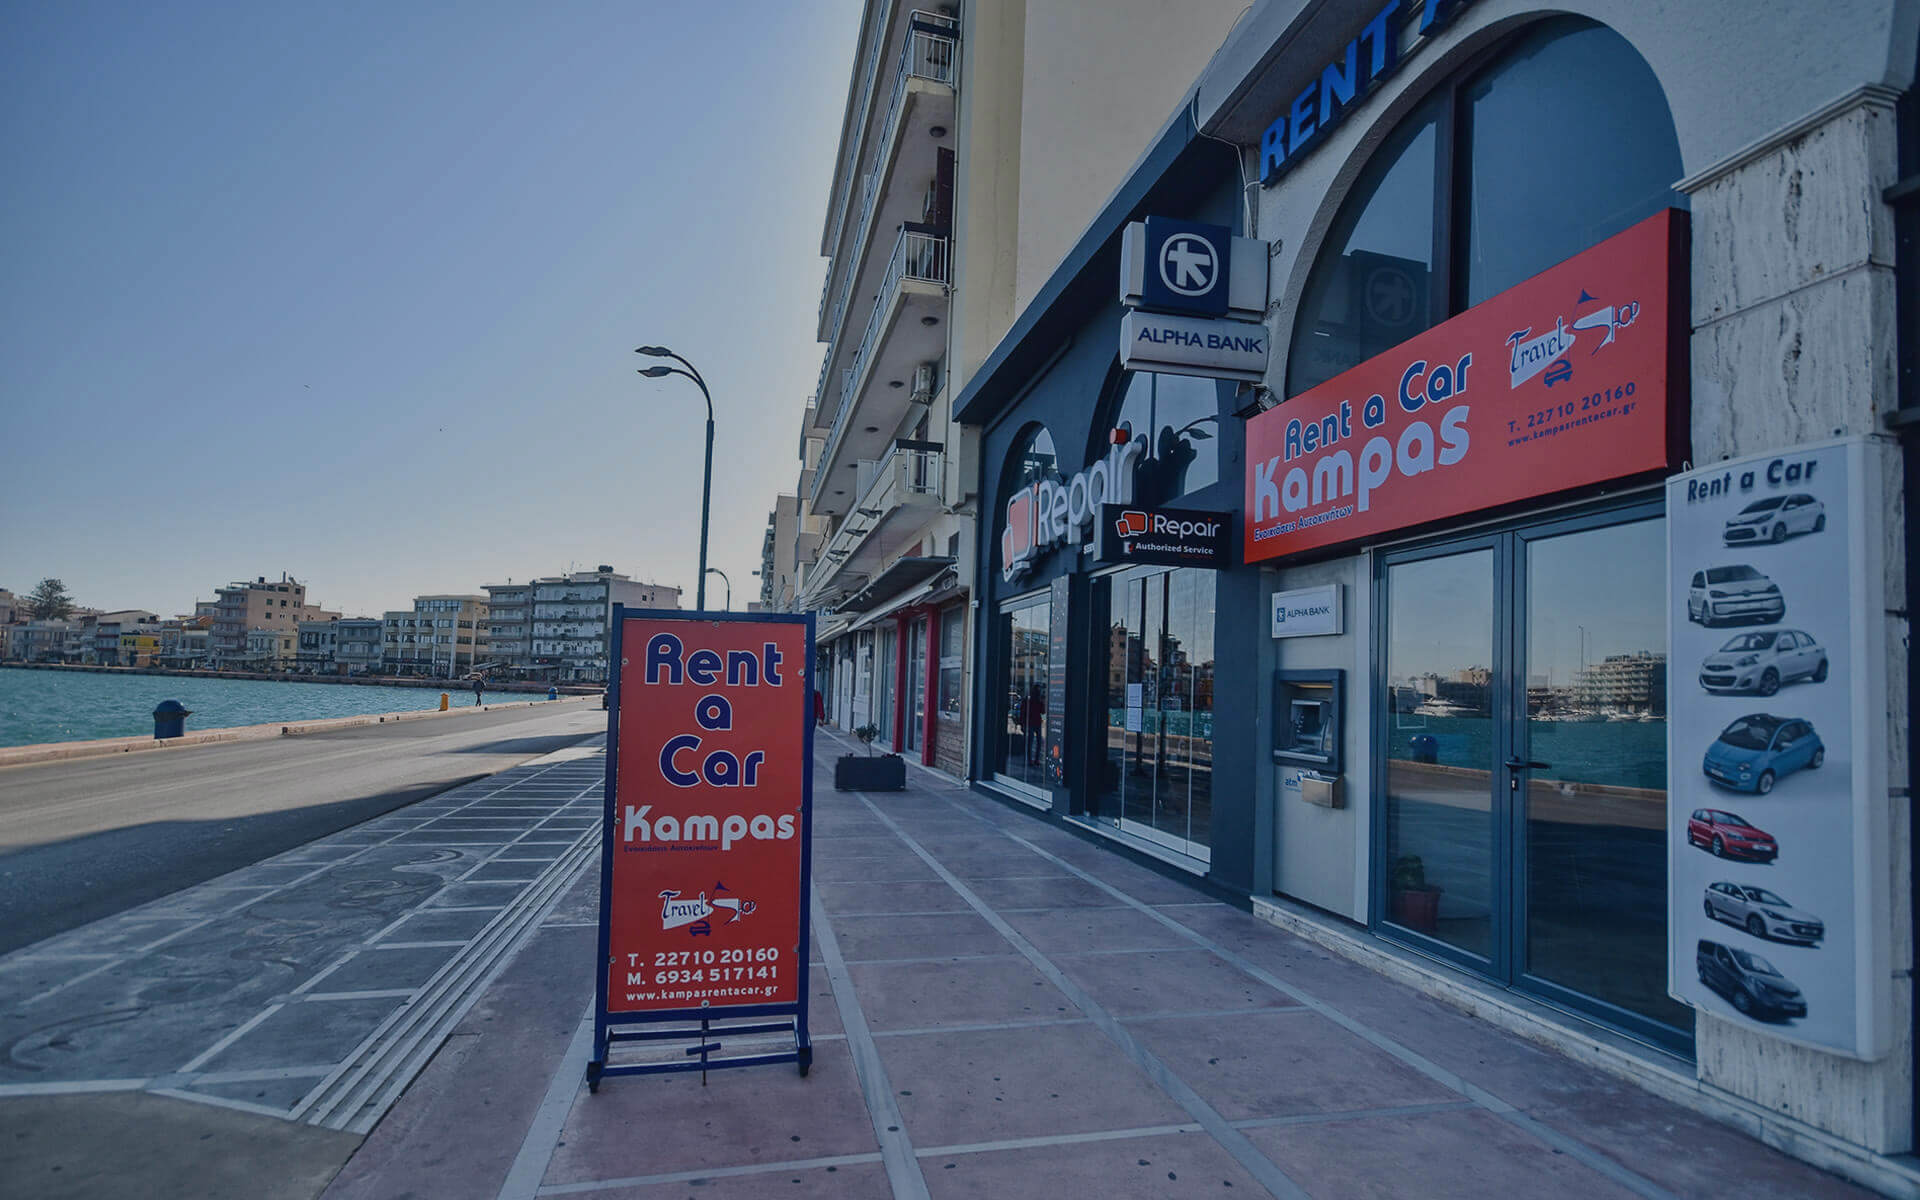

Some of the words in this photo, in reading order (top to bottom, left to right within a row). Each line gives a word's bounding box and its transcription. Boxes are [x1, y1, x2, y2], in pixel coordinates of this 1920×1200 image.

[1260, 0, 1400, 184] RENT
[1138, 327, 1203, 348] ALPHA
[1207, 334, 1264, 353] BANK
[1505, 316, 1565, 373] Travel
[1284, 400, 1352, 463] Rent
[1363, 394, 1385, 428] a
[1399, 352, 1472, 412] Car
[1508, 421, 1521, 433] T.
[1527, 402, 1575, 428] 22710
[1581, 382, 1636, 410] 20160
[1508, 401, 1636, 447] www.kampasrentacar.gr
[1254, 405, 1471, 523] Kampas
[1687, 472, 1732, 502] Rent
[1740, 470, 1754, 489] a
[1767, 459, 1817, 485] Car
[1032, 427, 1143, 546] iRepair
[1149, 513, 1221, 539] iRepair
[1135, 542, 1182, 554] Authorized
[1183, 544, 1214, 555] Service
[1287, 608, 1308, 618] ALPHA
[1309, 606, 1330, 616] BANK
[645, 632, 783, 687] Rent
[695, 693, 733, 731] a
[658, 734, 765, 788] Car
[623, 805, 795, 851] Kampas
[657, 889, 706, 920] Travel
[627, 953, 645, 967] T.
[654, 951, 715, 967] 22710
[720, 948, 779, 963] 20160
[627, 972, 646, 985] M.
[655, 969, 703, 984] 6934
[709, 965, 778, 982] 517141
[626, 985, 778, 1001] www.kampasrentacar.gr
